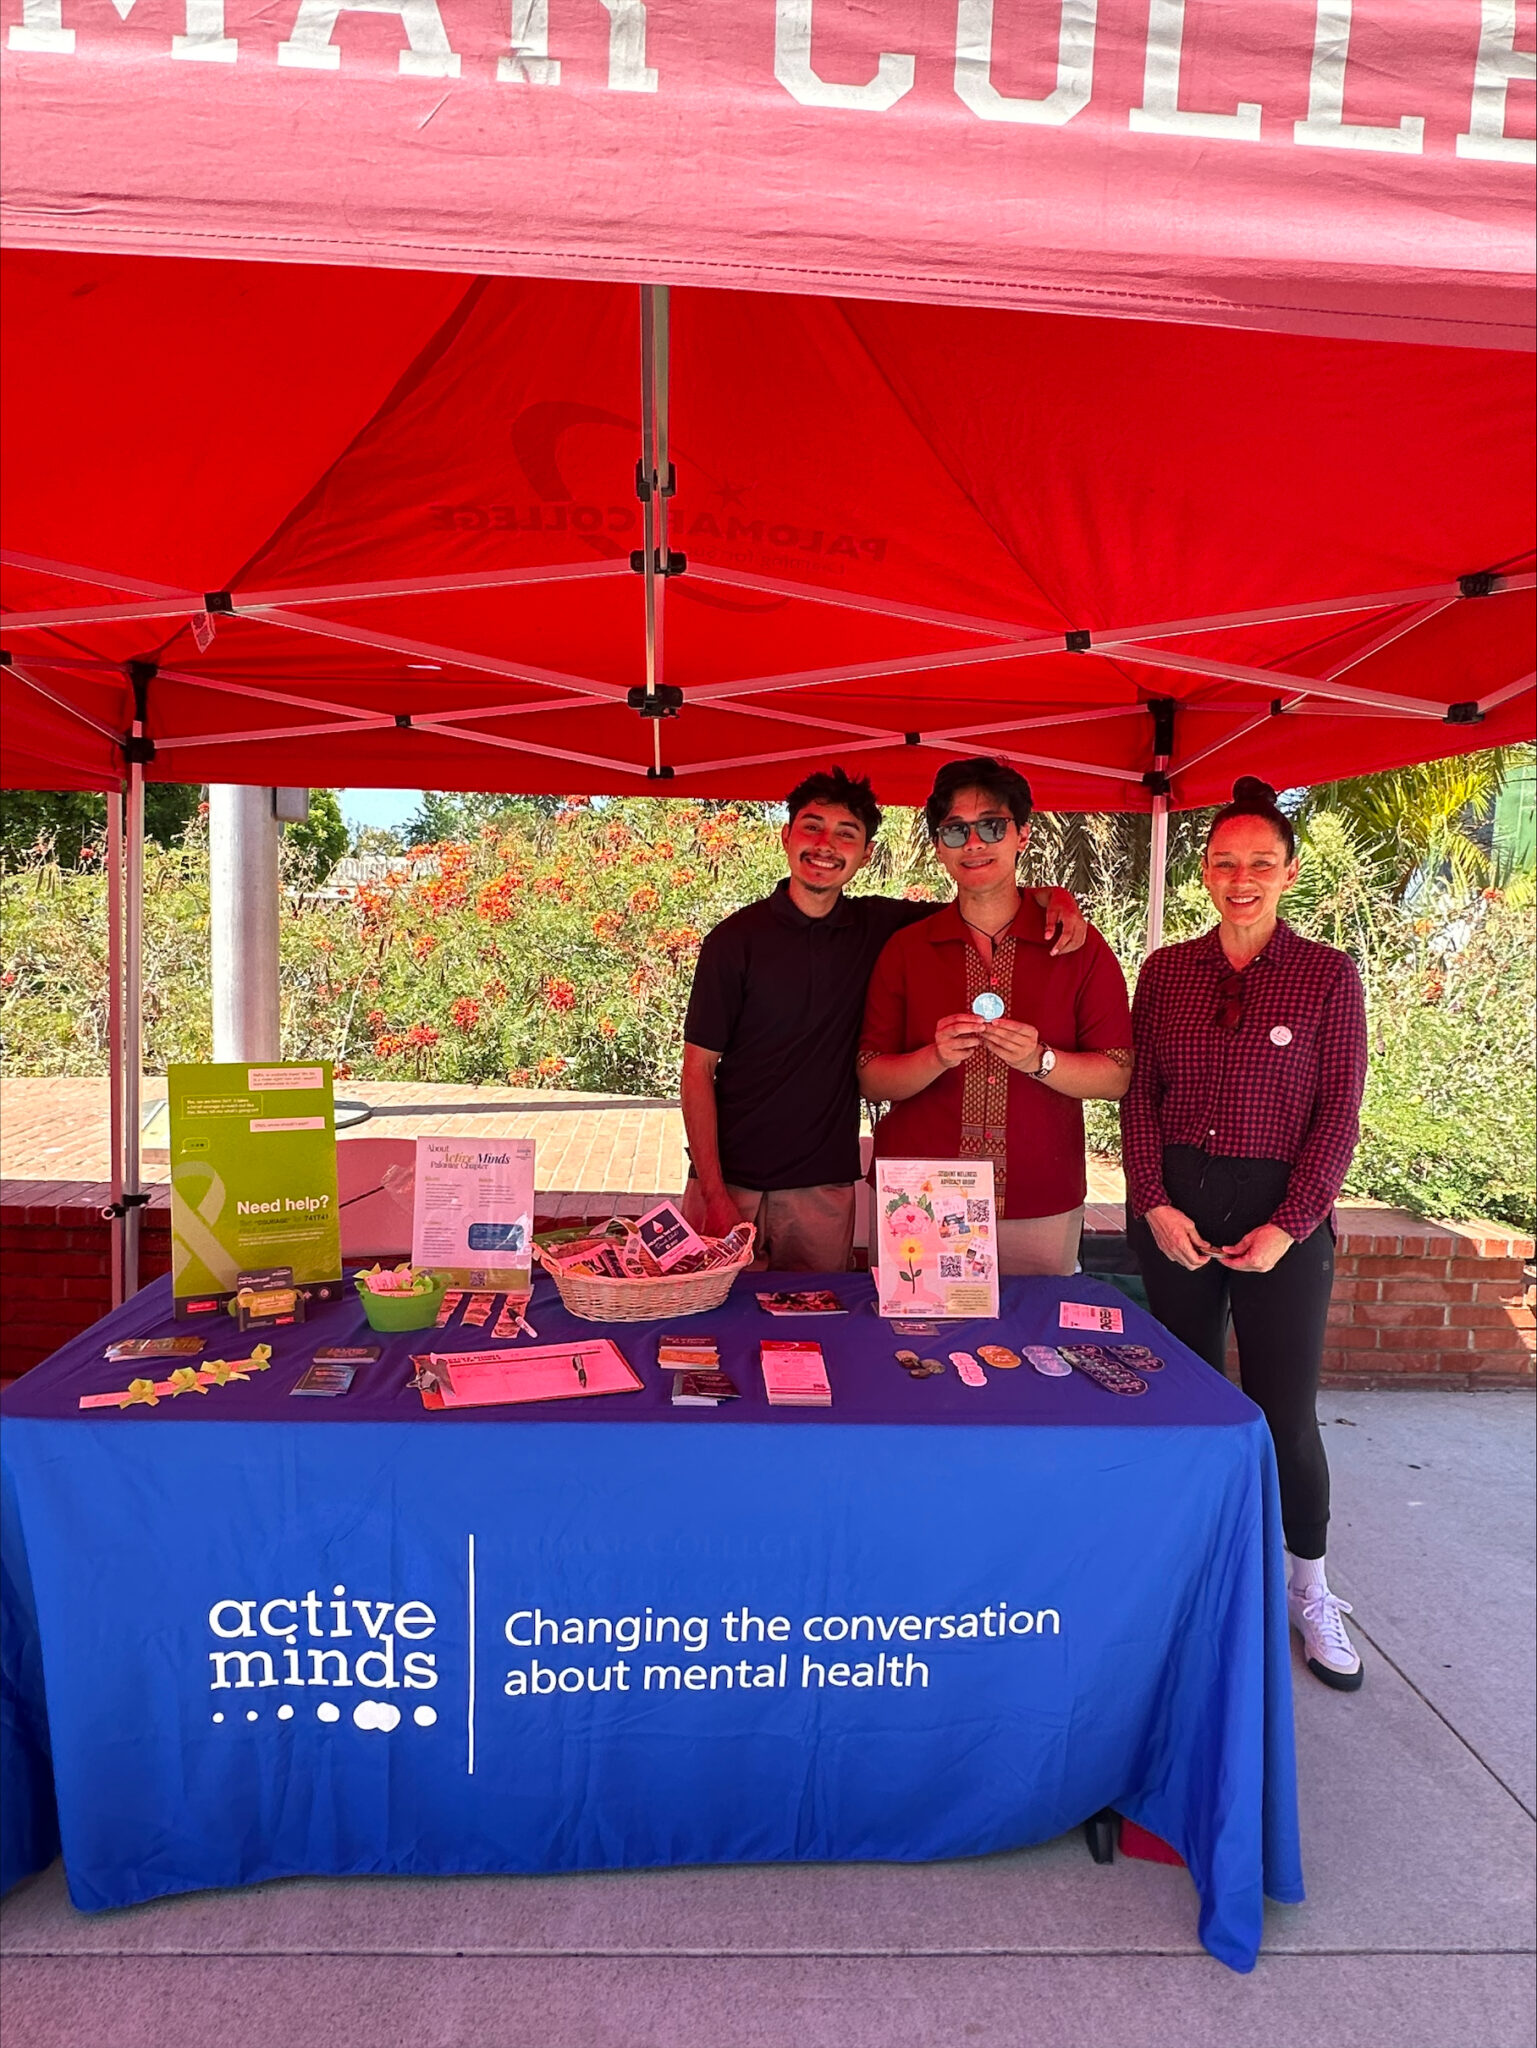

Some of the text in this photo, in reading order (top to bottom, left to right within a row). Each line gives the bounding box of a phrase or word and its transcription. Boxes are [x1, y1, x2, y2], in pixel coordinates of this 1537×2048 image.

[428, 1144, 449, 1153] About
[477, 1153, 511, 1164] Minds
[237, 1194, 329, 1215] Need help?
[208, 1584, 437, 1640] active
[504, 1601, 1060, 1652] Changing the conversation
[208, 1634, 439, 1690] minds
[503, 1652, 930, 1696] about mental health
